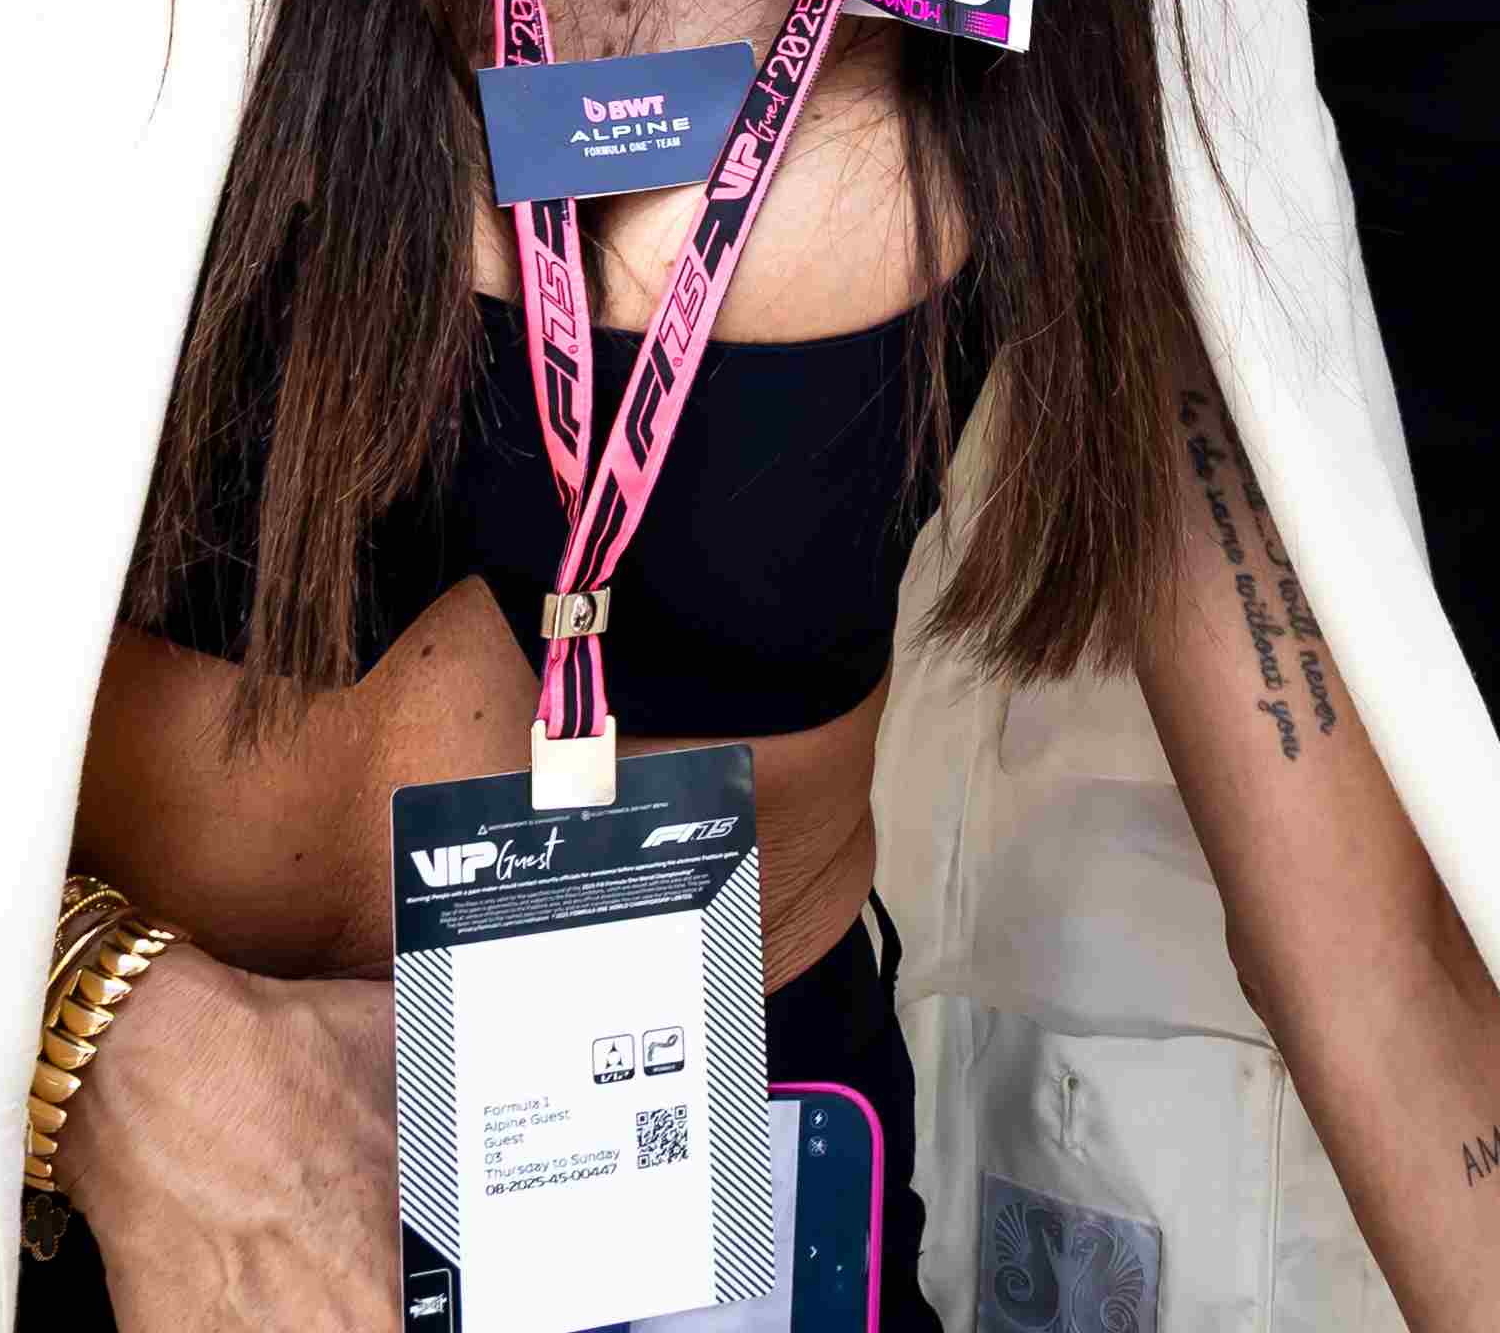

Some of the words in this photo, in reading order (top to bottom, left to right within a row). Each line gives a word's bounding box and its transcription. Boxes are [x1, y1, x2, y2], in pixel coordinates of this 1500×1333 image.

[608, 95, 665, 121] BWT
[570, 117, 692, 144] ALPINE
[583, 141, 628, 158] FORMULA
[655, 136, 682, 150] TEAM
[712, 131, 766, 202] VIP
[746, 78, 791, 144] Guest
[1205, 485, 1246, 566] same
[1234, 572, 1287, 694] without
[1299, 648, 1339, 737] never
[1256, 698, 1303, 762] you
[410, 841, 499, 888] VIP
[496, 826, 566, 882] Guest
[483, 1099, 540, 1117] Formula
[483, 1116, 527, 1134] Alpine
[530, 1108, 572, 1127] Guest
[483, 1133, 525, 1149] Guest
[483, 1162, 550, 1181] Thursday
[551, 1155, 569, 1169] to
[570, 1147, 622, 1168] Sunday
[484, 1163, 619, 1197] 08-2025-45-00447
